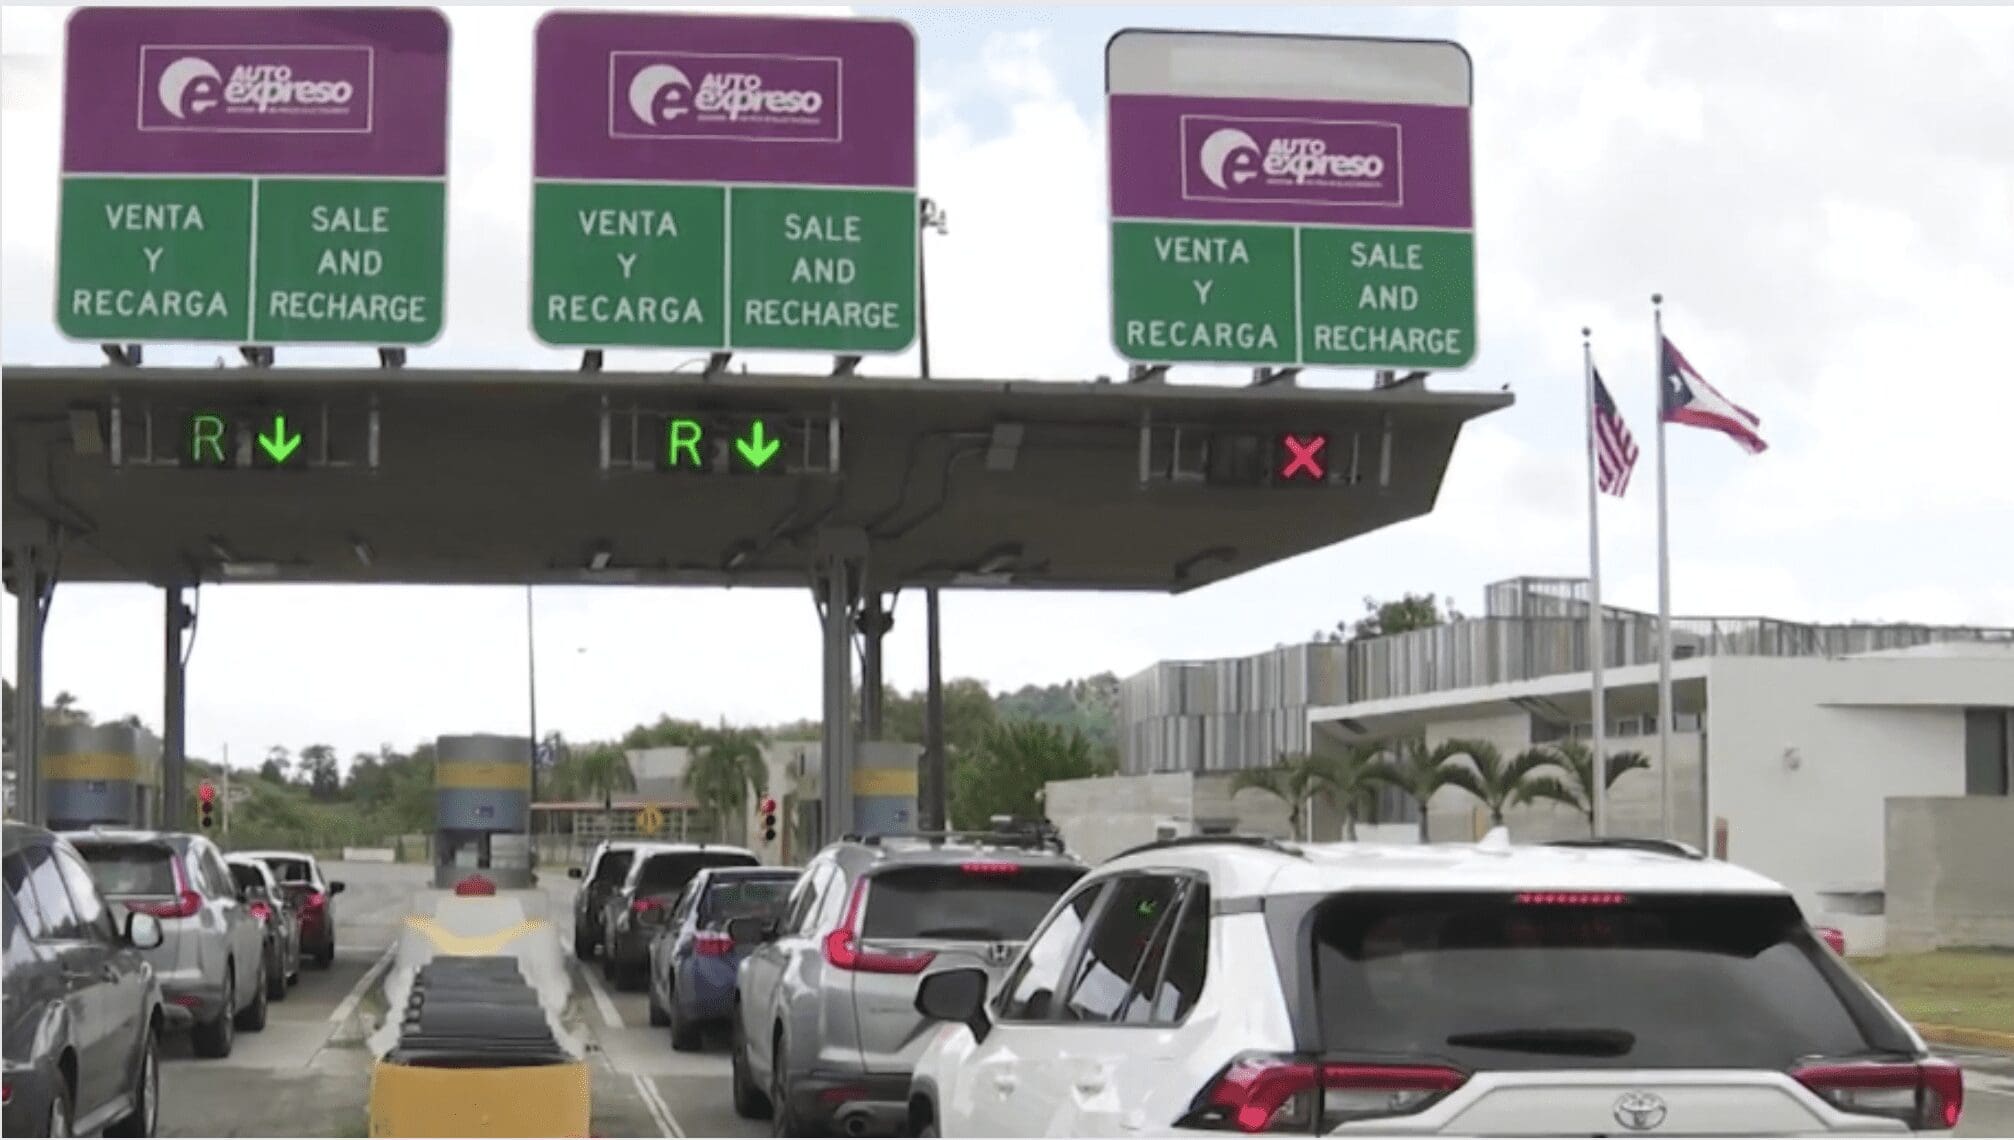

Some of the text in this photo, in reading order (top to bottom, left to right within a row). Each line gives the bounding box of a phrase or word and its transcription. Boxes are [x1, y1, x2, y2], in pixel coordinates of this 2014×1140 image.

[230, 65, 292, 83] AUTO
[699, 72, 762, 90] AUTO
[224, 80, 353, 113] expreso
[695, 87, 823, 121] expreso
[1267, 138, 1327, 155] AUTO
[1263, 153, 1385, 184] expreso
[107, 205, 202, 229] VENTA
[313, 206, 388, 232] SALE
[580, 210, 677, 236] VENTA
[785, 214, 861, 241] SALE
[144, 248, 163, 272] Y
[318, 250, 382, 275] AND
[1155, 237, 1249, 263] VENTA
[1351, 243, 1423, 269] SALE
[618, 255, 636, 278] Y
[792, 259, 856, 283] AND
[73, 290, 228, 317] RECARGA
[1194, 281, 1212, 304] Y
[1359, 285, 1418, 311] AND
[270, 292, 425, 321] RECHARGE
[548, 296, 703, 322] RECARGA
[745, 300, 898, 328] RECHARGE
[1127, 321, 1278, 348] RECARGA
[1315, 326, 1461, 354] RECHARGE
[193, 415, 226, 462] R
[669, 419, 703, 465] R
